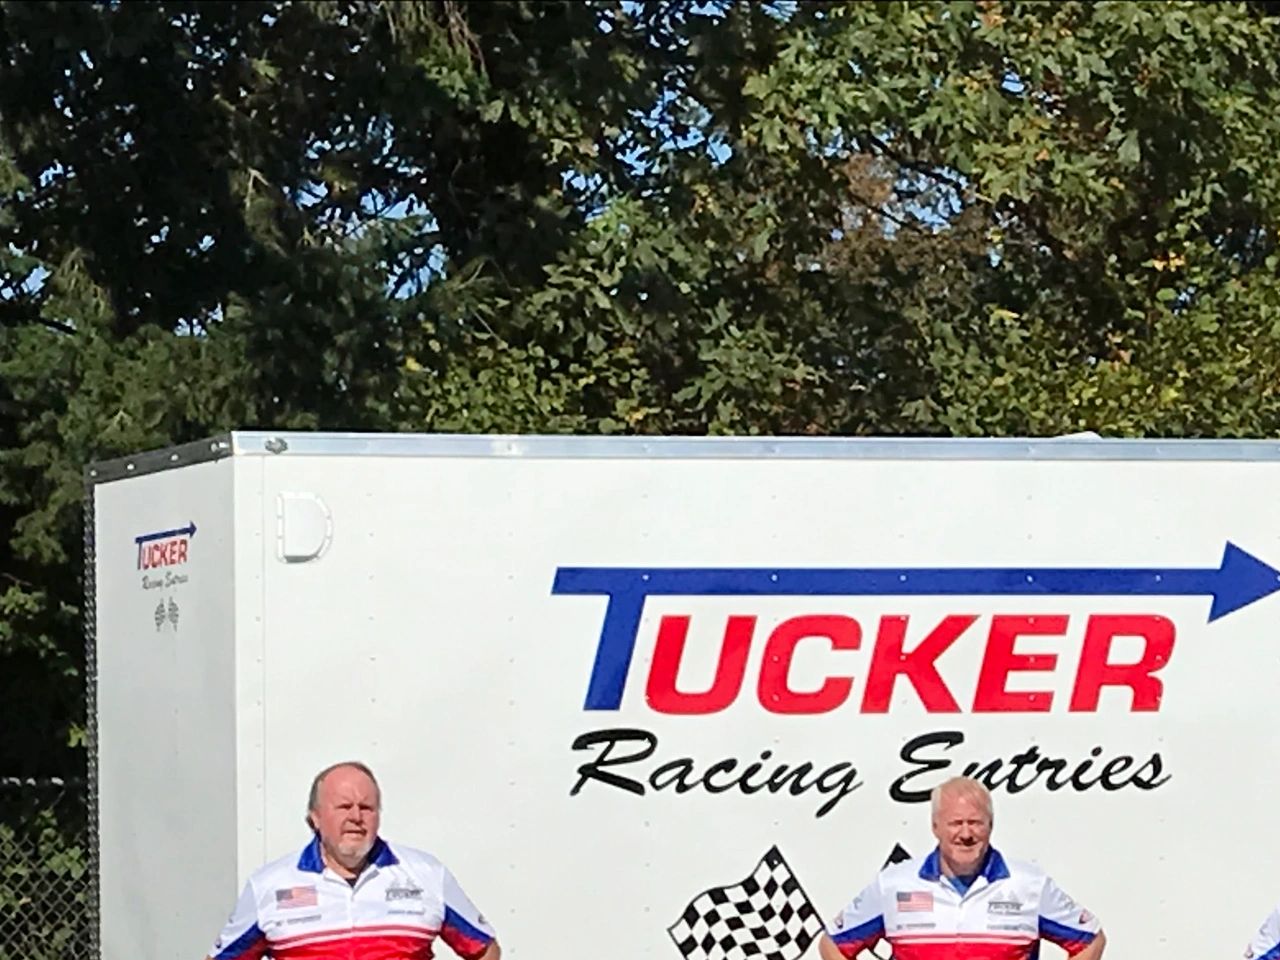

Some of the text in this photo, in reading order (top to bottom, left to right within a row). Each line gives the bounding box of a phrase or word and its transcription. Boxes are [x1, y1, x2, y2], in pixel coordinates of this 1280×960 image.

[135, 530, 188, 570] TUCKER
[552, 567, 1180, 716] TUCKER
[570, 729, 1172, 819] Racing Entries
